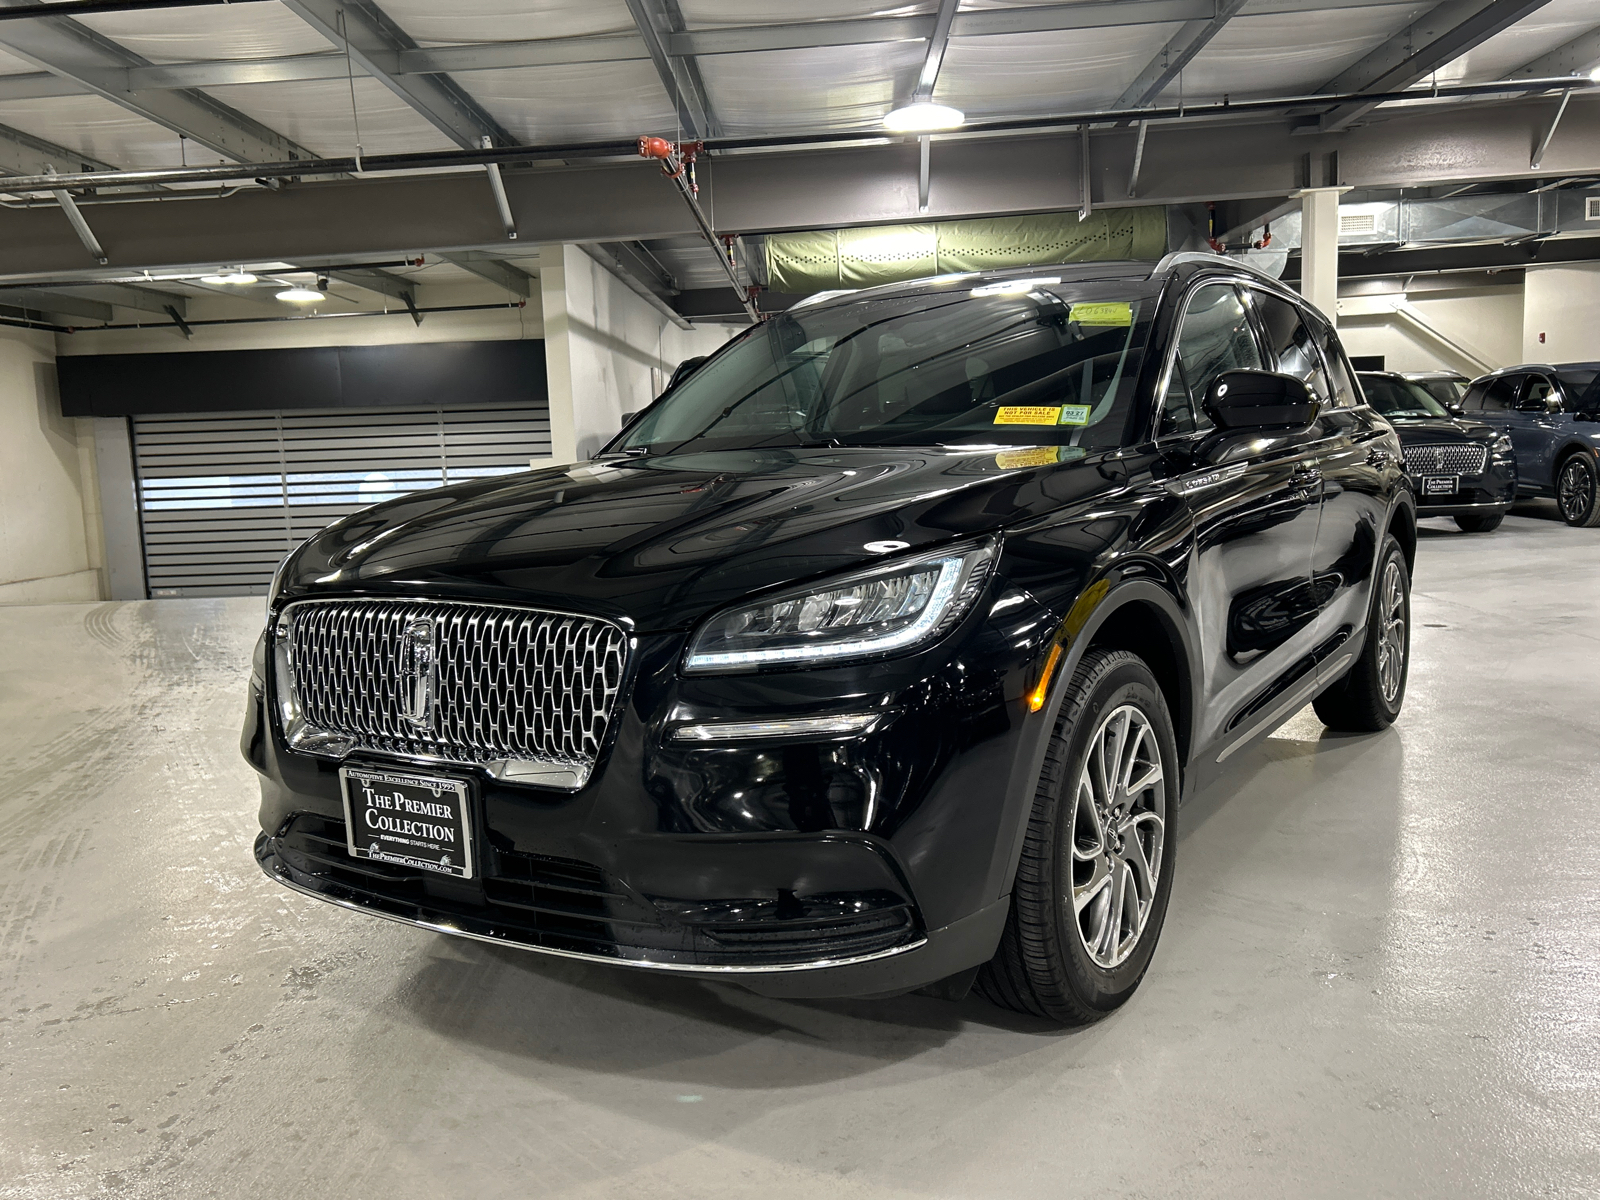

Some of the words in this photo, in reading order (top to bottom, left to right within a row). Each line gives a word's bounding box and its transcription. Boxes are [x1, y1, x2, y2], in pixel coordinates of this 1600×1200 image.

[348, 770, 384, 781] AUTOMOTIVE
[384, 775, 418, 786] EXCELLENCE
[419, 779, 437, 789] SINCE
[438, 781, 455, 791] 1995
[362, 787, 393, 810] THE
[392, 791, 453, 819] PREMIER
[365, 808, 455, 843] COLLECTION
[380, 834, 410, 845] EVERYTHING
[409, 839, 427, 849] STARTS
